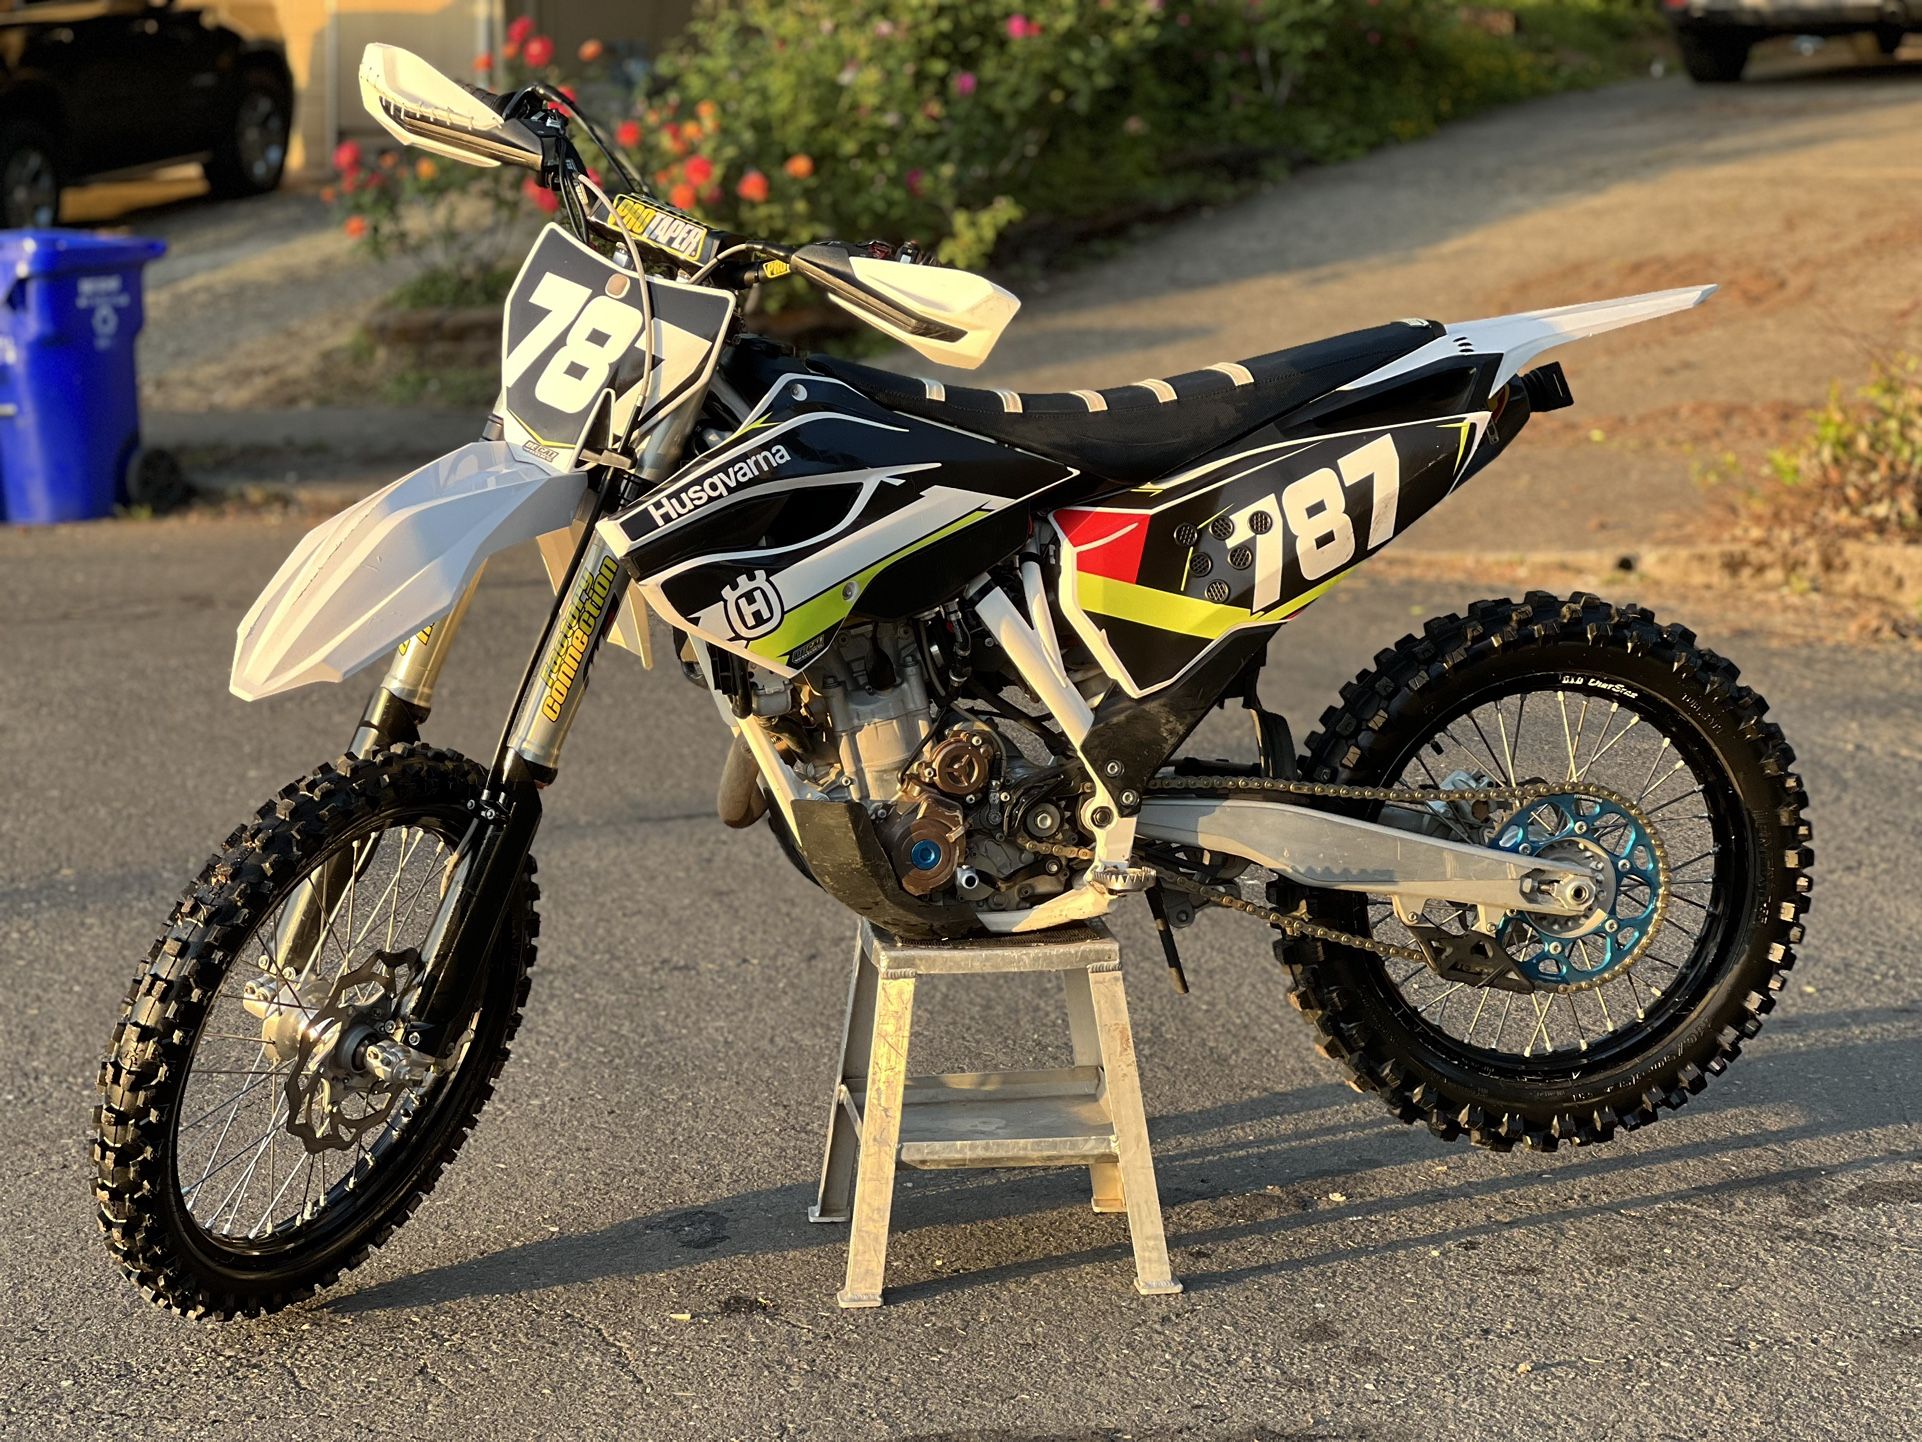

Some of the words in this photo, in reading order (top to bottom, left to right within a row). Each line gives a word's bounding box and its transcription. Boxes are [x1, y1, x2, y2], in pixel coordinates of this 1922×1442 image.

[506, 271, 713, 437] 787
[647, 444, 792, 527] Husqvarna
[1224, 432, 1400, 613] 787
